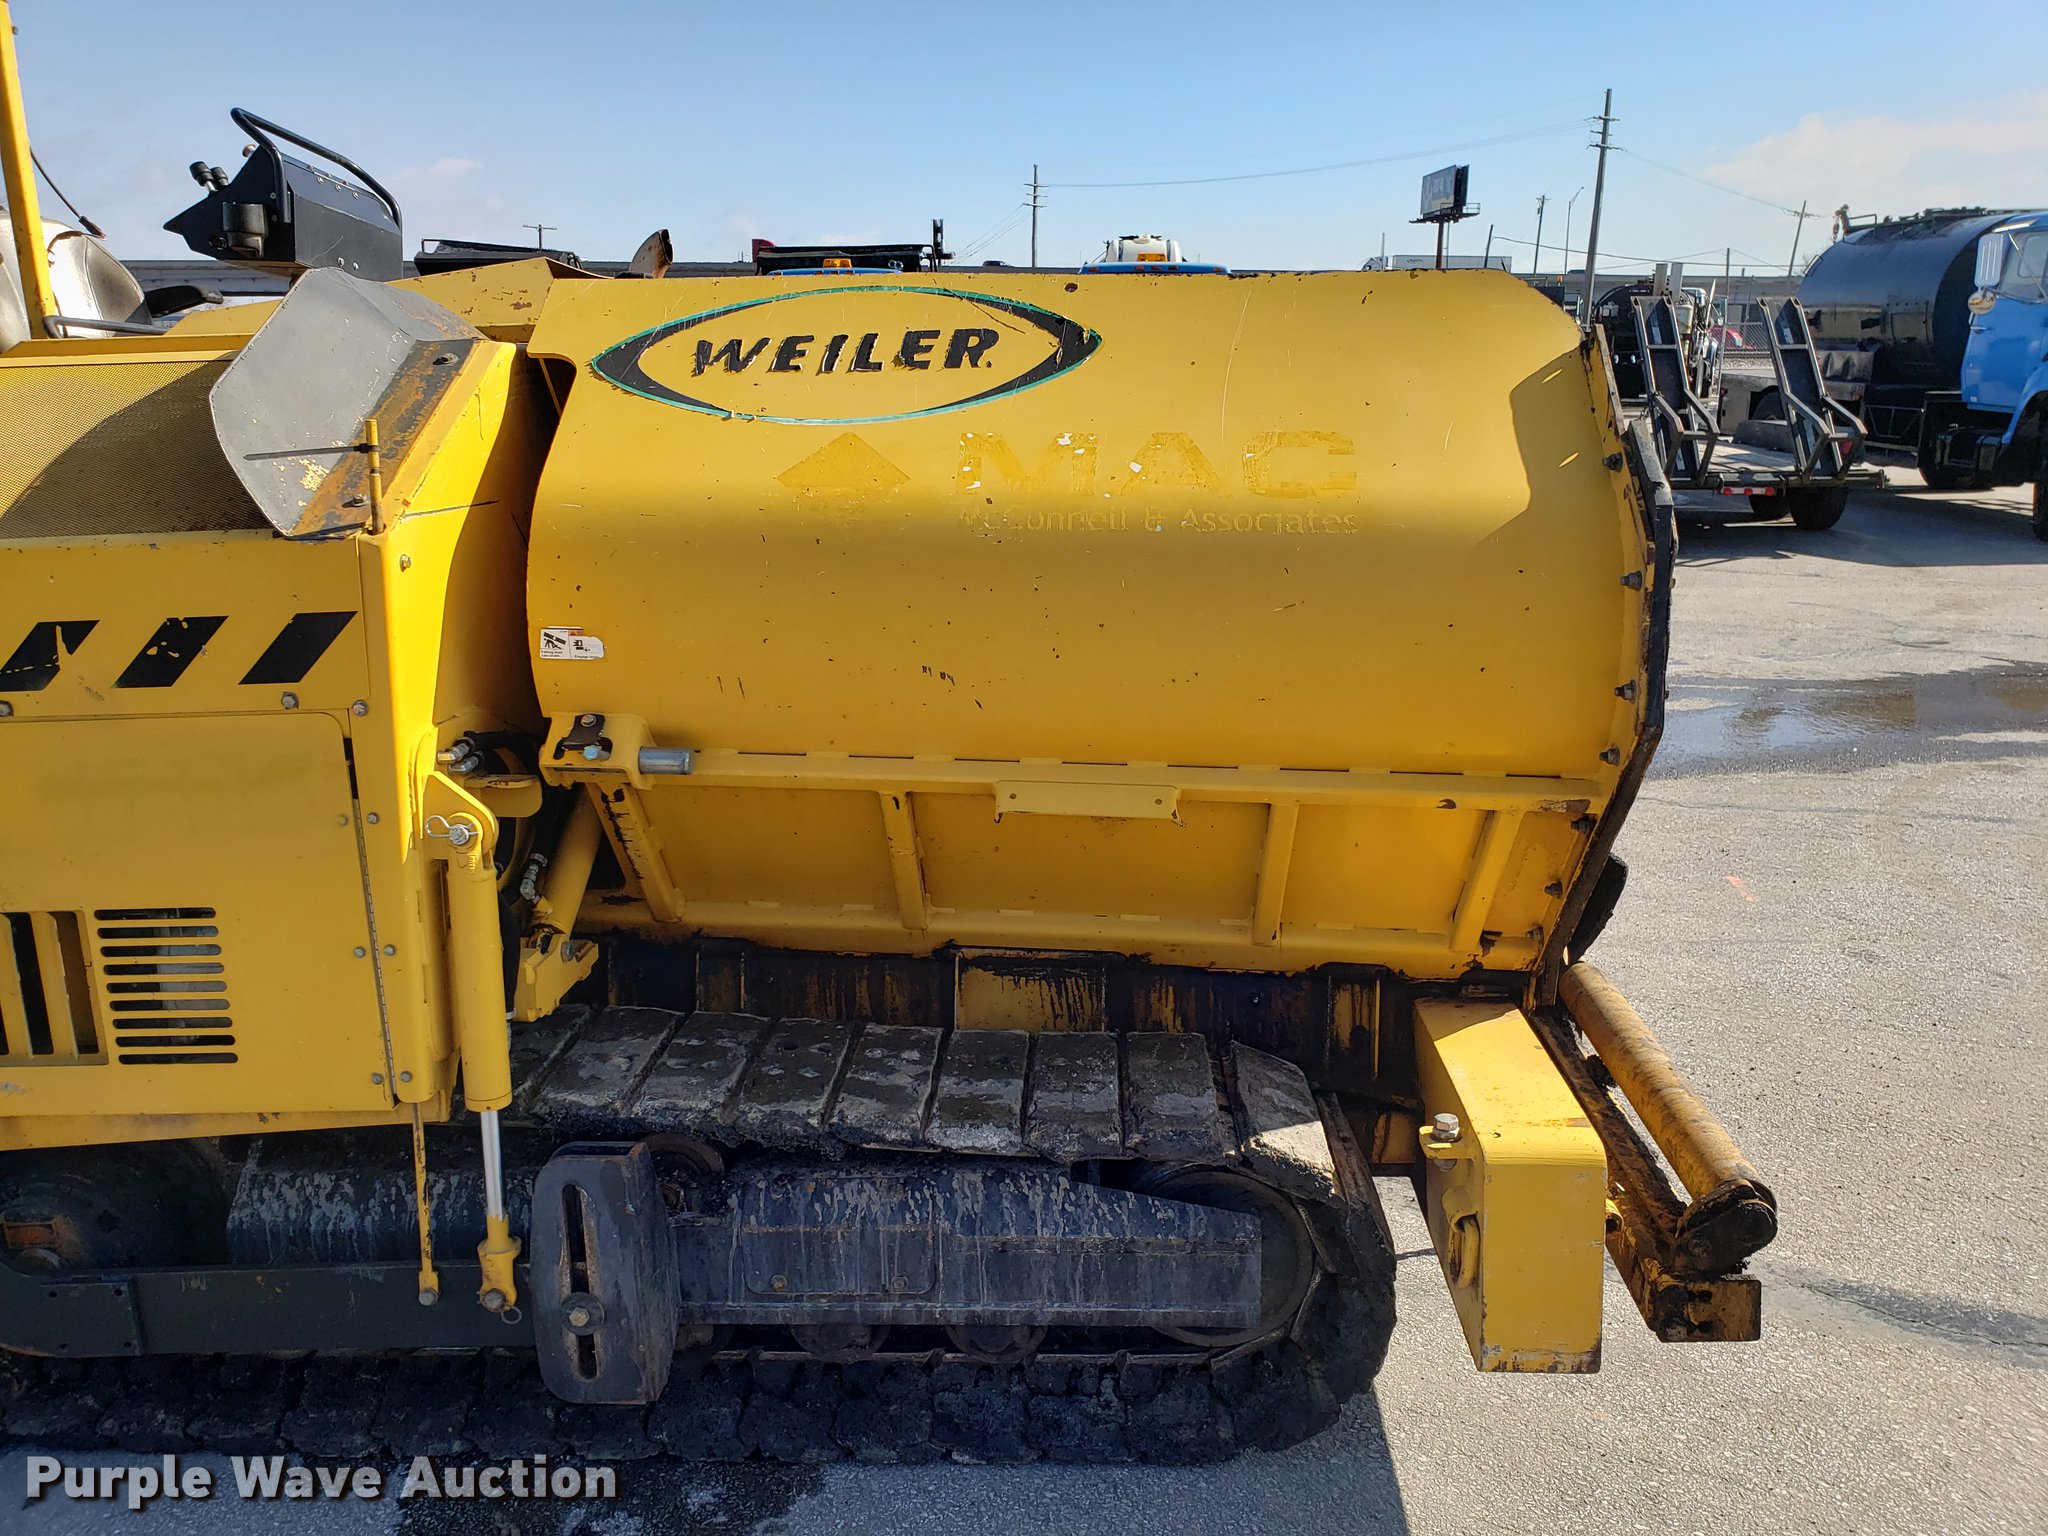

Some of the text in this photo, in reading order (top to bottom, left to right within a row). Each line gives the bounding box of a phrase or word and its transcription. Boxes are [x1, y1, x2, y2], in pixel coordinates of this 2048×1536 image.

[692, 328, 999, 376] WEILER
[959, 432, 1358, 499] MAC
[1181, 507, 1360, 535] Associates
